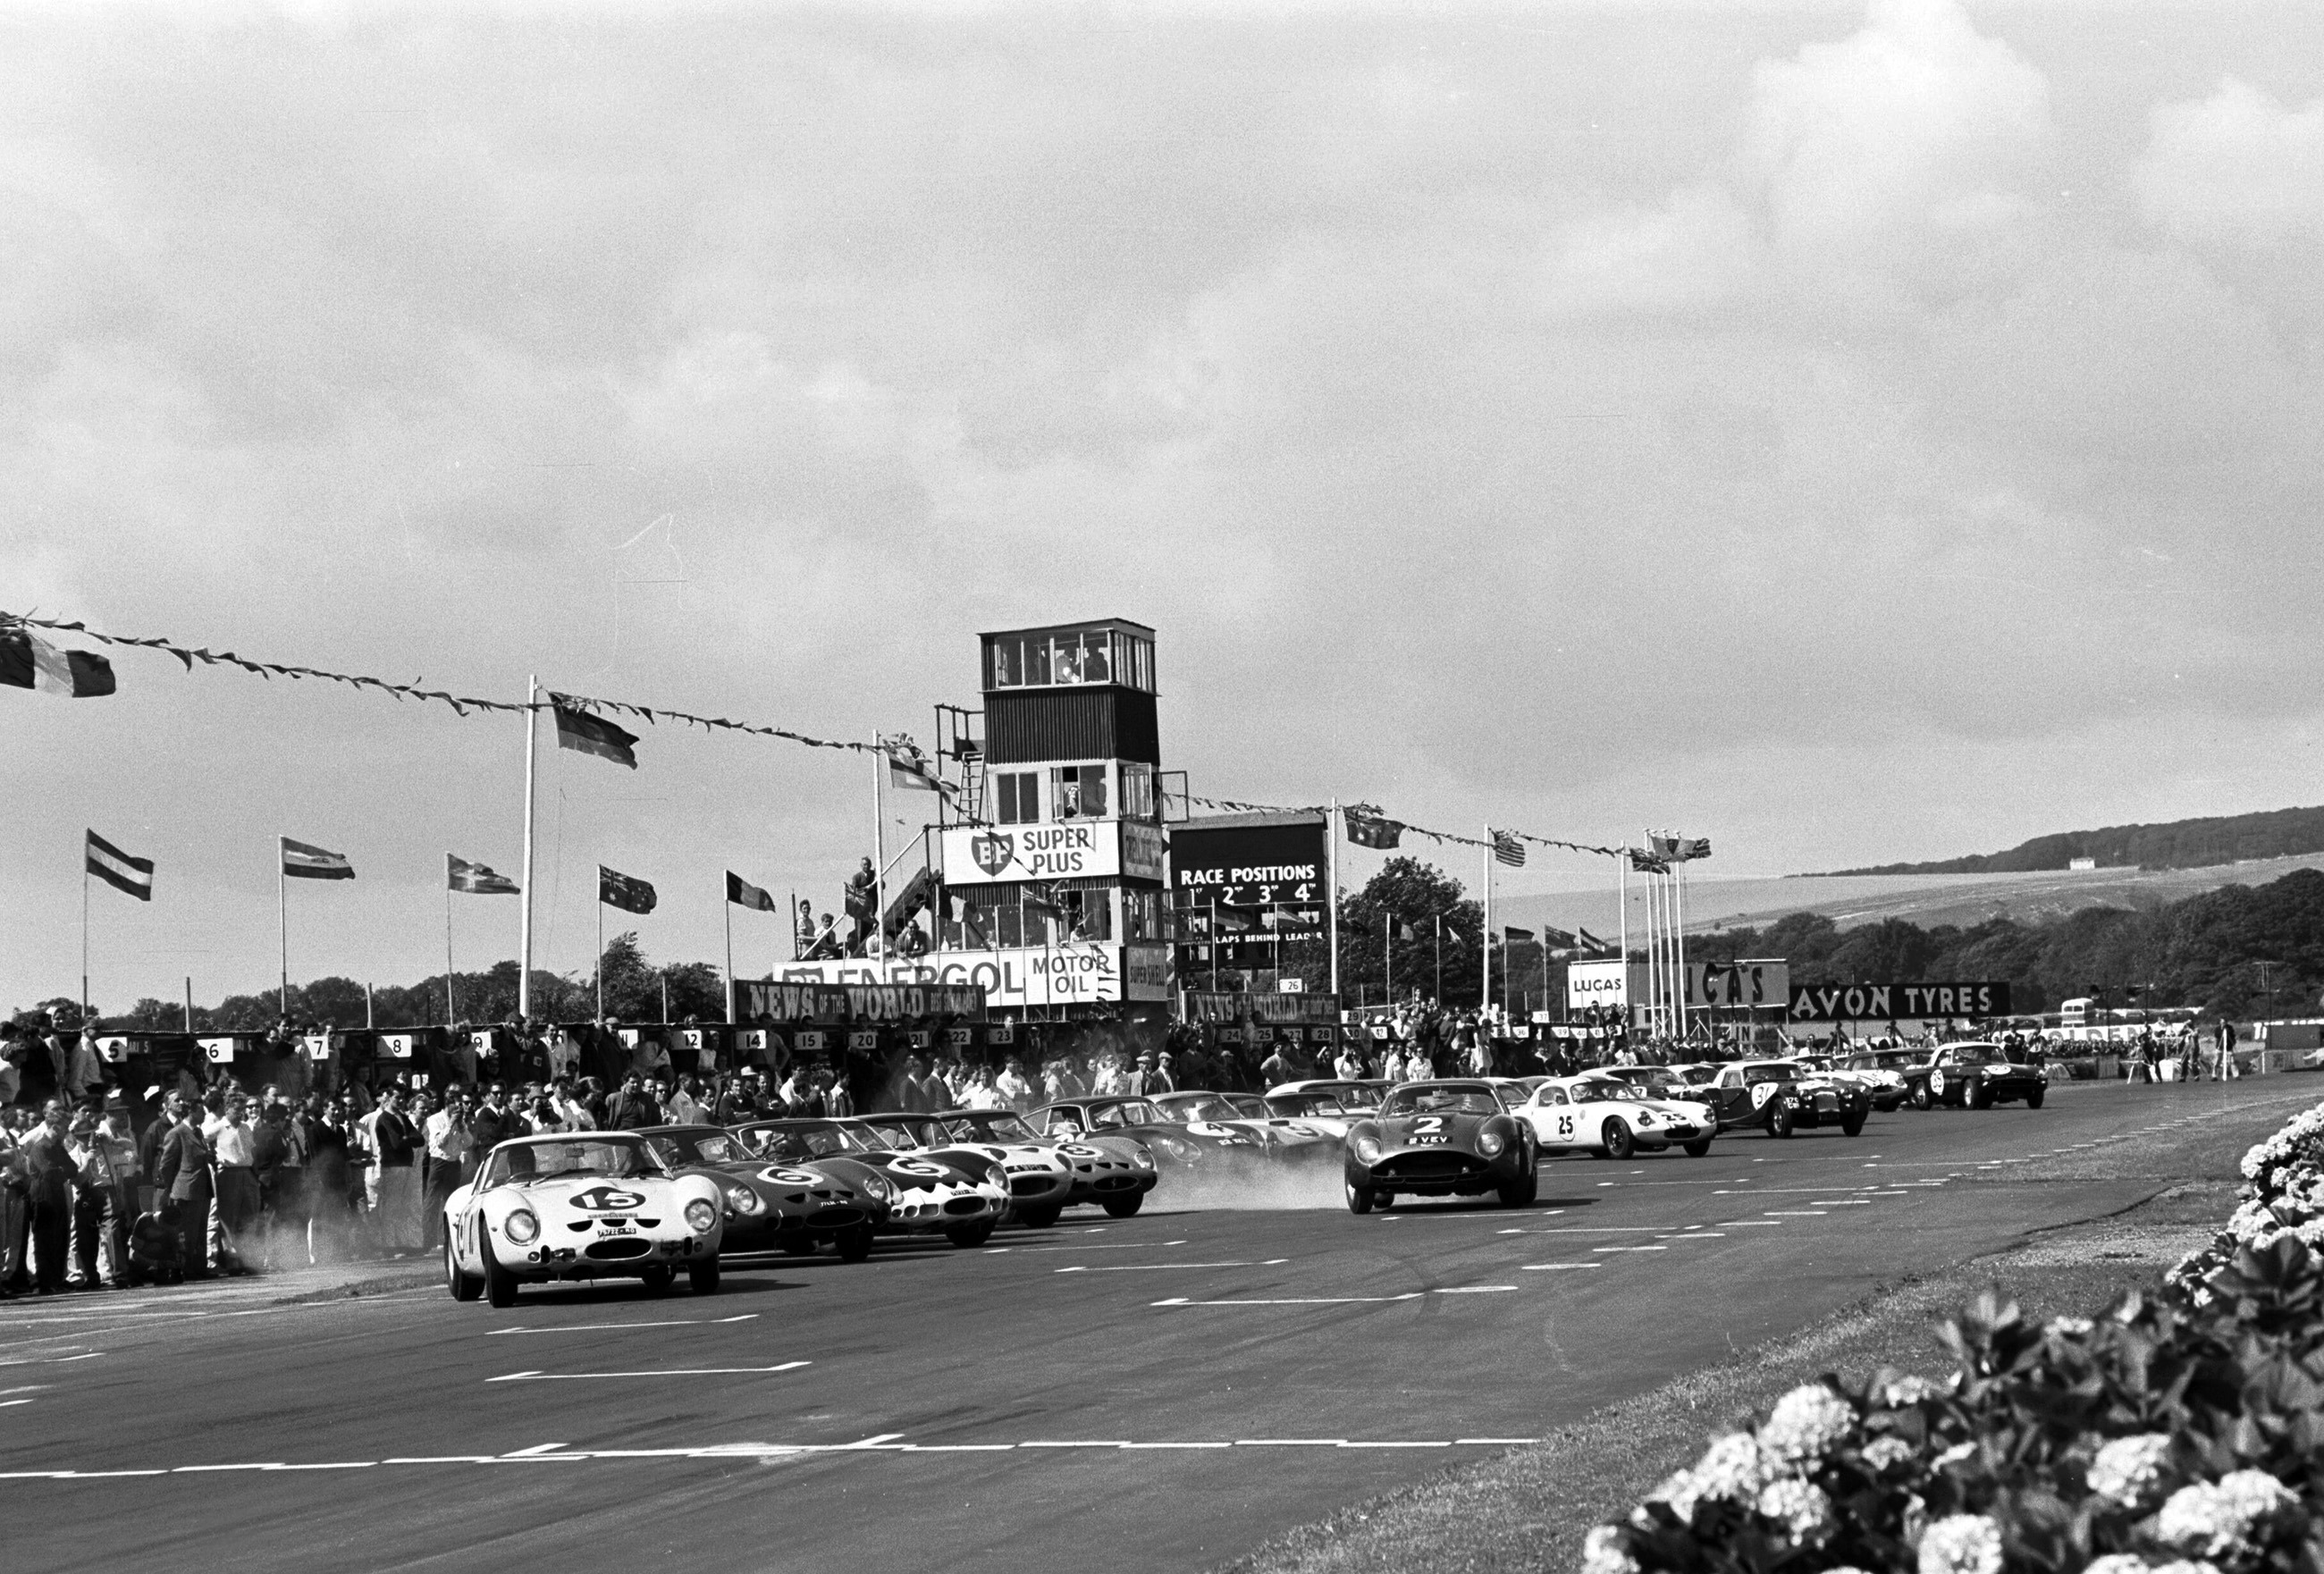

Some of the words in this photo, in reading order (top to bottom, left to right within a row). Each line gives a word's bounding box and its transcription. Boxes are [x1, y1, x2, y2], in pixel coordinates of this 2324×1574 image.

[1023, 828, 1089, 851] SUPER
[978, 840, 1011, 865] BP
[1033, 852, 1083, 875] PLUS
[1181, 869, 1224, 885] RACE
[1231, 864, 1316, 883] POSITIONS
[1216, 935, 1240, 944] LAPS
[1245, 934, 1281, 943] BEHIND
[1285, 931, 1323, 941] LEADR
[1033, 955, 1109, 974] MOTOR
[1055, 976, 1090, 993] OIL
[1287, 980, 1299, 990] 26
[1574, 978, 1621, 992] LUCAS
[749, 984, 814, 1020] NEWS
[819, 994, 828, 1014] OF
[831, 994, 845, 1014] THE
[848, 986, 924, 1021] WORLD
[1791, 986, 1890, 1018] AVON
[1905, 986, 1991, 1013] TYRES
[1348, 1012, 1359, 1021] 29
[685, 1033, 698, 1047] 12
[912, 1034, 923, 1046] 21
[952, 1031, 967, 1043] 22
[998, 1031, 1011, 1042] 23
[1227, 1031, 1239, 1041] 24
[1259, 1030, 1271, 1040] 25
[1318, 1030, 1330, 1040] 28
[1557, 1029, 1567, 1037] 39
[313, 1040, 324, 1056] 7
[392, 1039, 402, 1054] 8
[474, 1037, 483, 1048] 9
[745, 1034, 762, 1048] 14
[802, 1035, 815, 1047] 15
[858, 1035, 873, 1047] 20
[108, 1040, 119, 1058] 5
[209, 1044, 219, 1058] 6
[1756, 1085, 1769, 1105] 31
[1414, 1117, 1443, 1133] 2
[1559, 1115, 1573, 1134] 25
[1661, 1114, 1687, 1122] 25
[1207, 1123, 1225, 1134] 4
[1421, 1135, 1447, 1143] VEV
[767, 1167, 813, 1183] 6
[582, 1191, 638, 1208] 15
